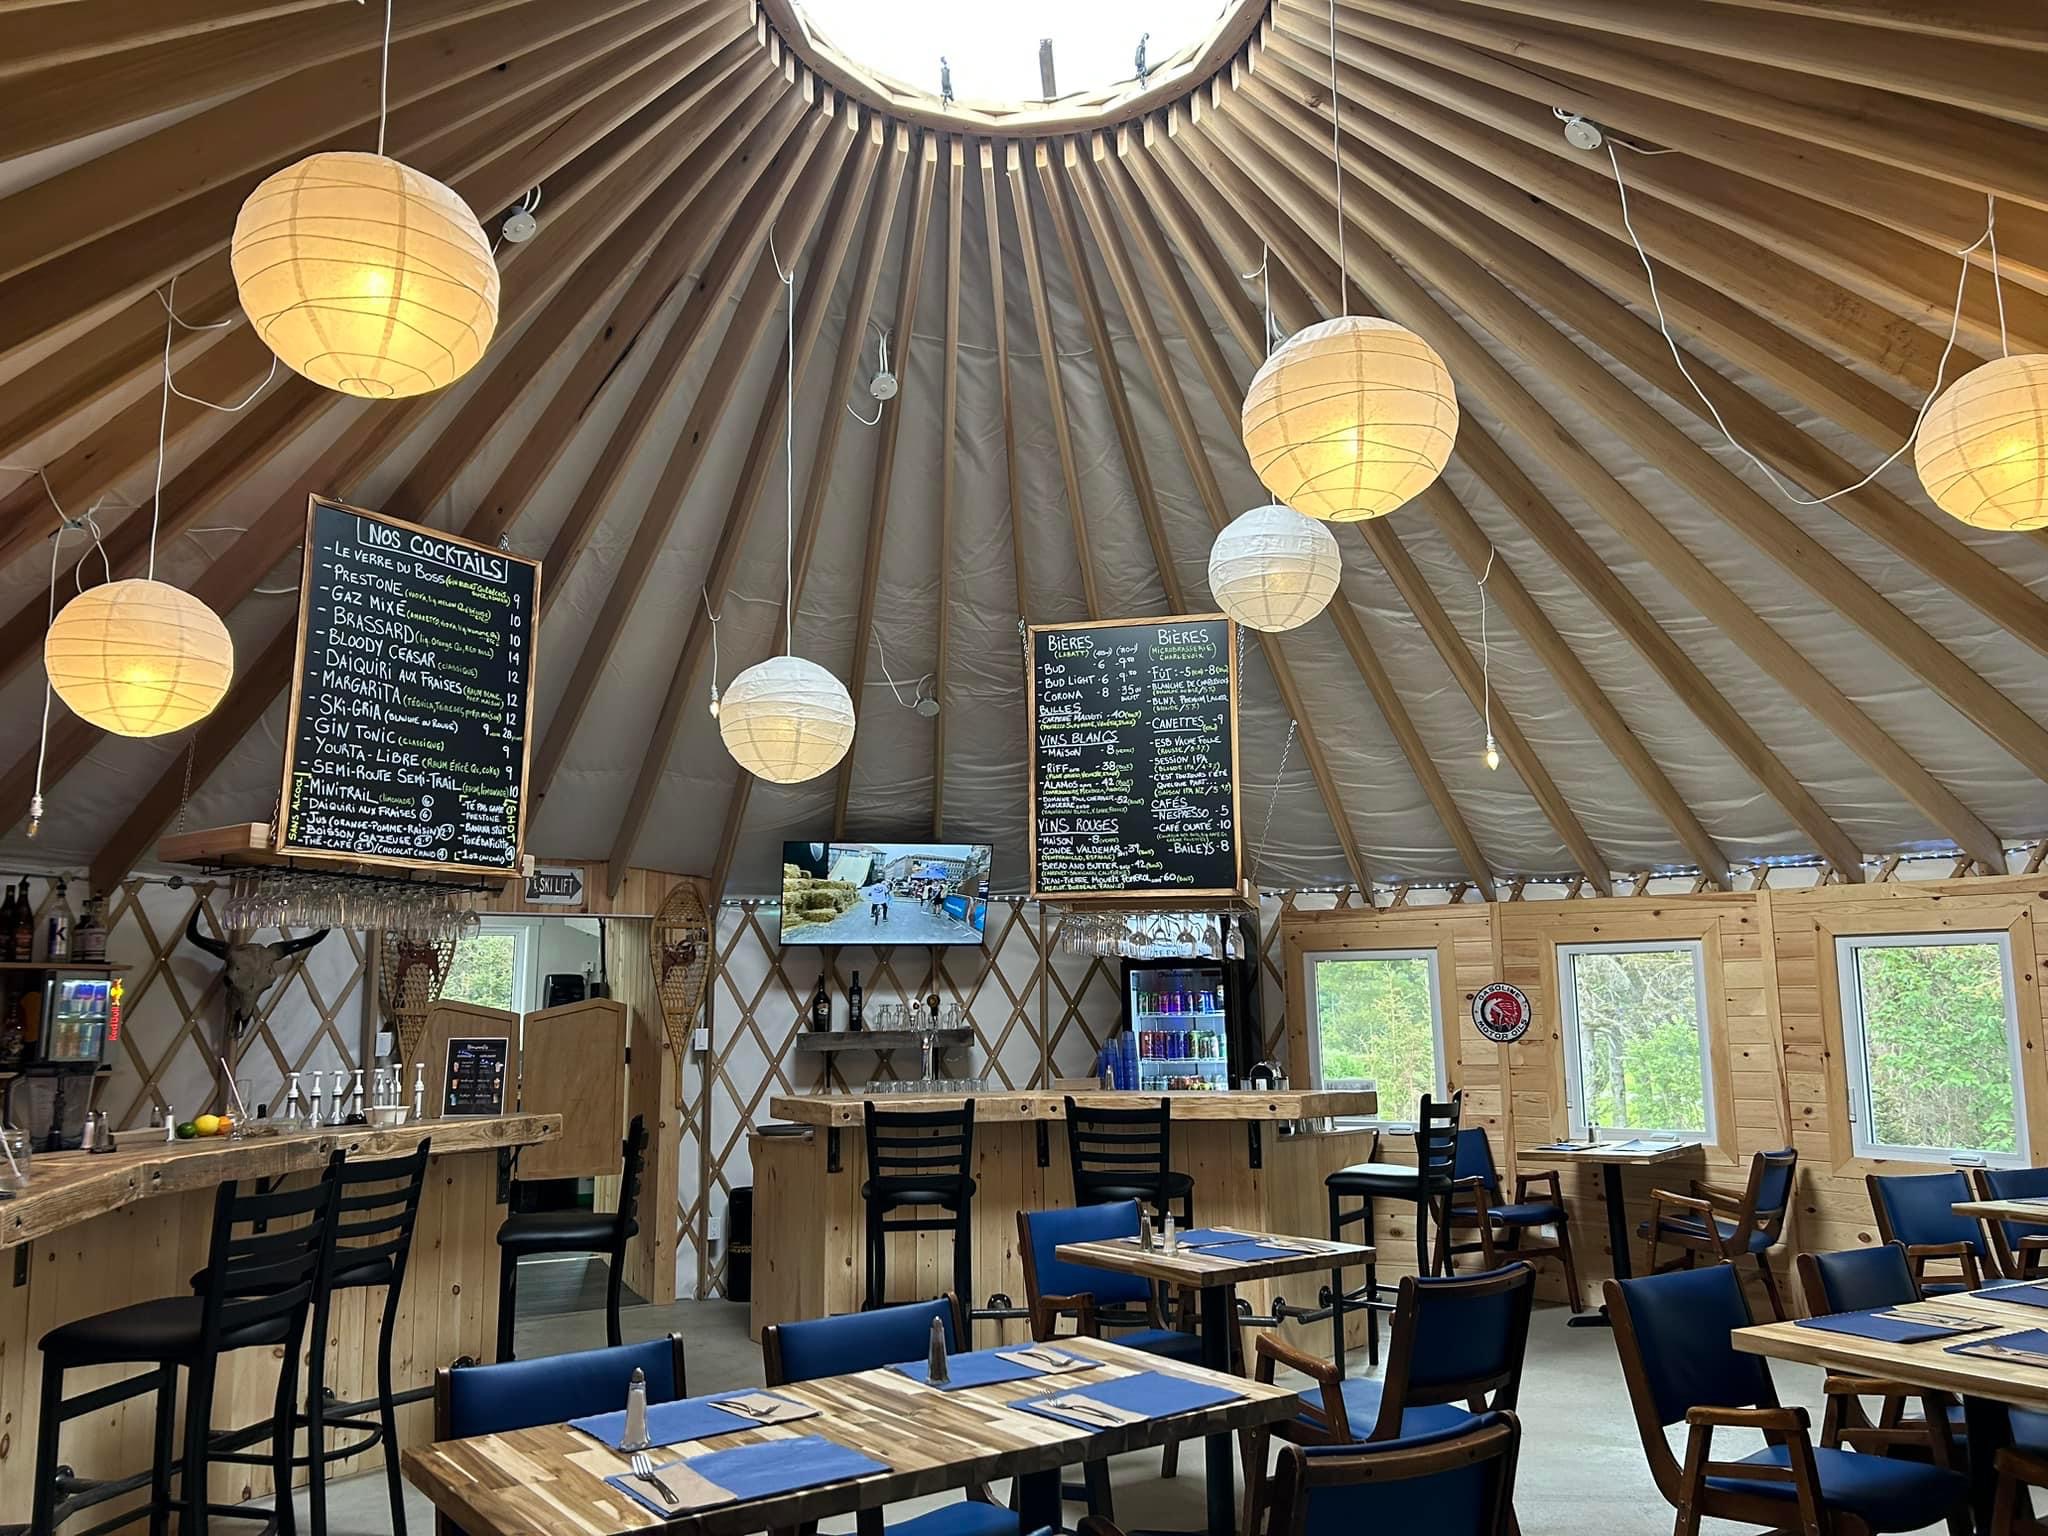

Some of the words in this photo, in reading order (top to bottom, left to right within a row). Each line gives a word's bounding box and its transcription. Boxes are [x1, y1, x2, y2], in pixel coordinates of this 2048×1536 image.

[369, 523, 401, 549] NOS
[335, 540, 351, 558] LE
[355, 549, 394, 570] VERRE
[397, 561, 411, 574] DU
[513, 593, 520, 610] 9
[334, 563, 403, 597] PRESTONE
[510, 613, 521, 628] 10
[332, 585, 362, 605] GAZ
[510, 633, 521, 648] 10
[334, 606, 415, 645] BRASSARD
[508, 650, 520, 666] 14
[329, 627, 383, 657] BLOODY
[388, 644, 436, 669] CEASAR
[508, 669, 520, 684] 12
[1044, 663, 1066, 675] BUD
[1097, 659, 1106, 669] 6
[1184, 666, 1192, 677] 5
[1208, 664, 1216, 675] 8
[399, 668, 417, 684] AUX
[507, 692, 519, 708] 12
[1044, 678, 1066, 689] BUD
[1101, 673, 1109, 685] 6
[1151, 681, 1184, 691] BLANCHE
[1043, 689, 1084, 702] CORONA
[1101, 686, 1110, 698] 8
[1121, 683, 1135, 696] 35
[1039, 702, 1082, 715] BULLES
[506, 712, 517, 726] 12
[1151, 715, 1205, 729] CANETTES
[1217, 714, 1224, 725] 9
[483, 723, 490, 736] 9
[502, 727, 512, 740] 28
[1071, 730, 1118, 744] BLANCS
[1106, 744, 1115, 755] 8
[1154, 738, 1172, 748] ESB
[502, 745, 510, 759] 9
[1192, 754, 1208, 764] IPA
[1101, 760, 1116, 771] 38
[505, 765, 513, 781] 9
[1043, 780, 1079, 790] ALAMOS
[1101, 778, 1115, 789] 42
[291, 777, 303, 811] ALCOOL
[509, 784, 519, 799] 10
[1151, 796, 1189, 809] CAFÉS
[306, 811, 327, 824] JUS
[358, 805, 376, 816] AUX
[465, 812, 501, 823] PRESTONE
[1158, 808, 1210, 820] NESPRESSO
[1219, 805, 1230, 816] 5
[288, 814, 300, 841] SANS
[1075, 818, 1119, 832] ROUGES
[1159, 820, 1181, 832] CAFÉ
[1220, 819, 1231, 830] 10
[358, 831, 412, 846] GAZEUSE
[1091, 834, 1101, 844] 8
[1042, 845, 1075, 855] CONDE
[1076, 844, 1120, 855] VALDEMAR
[1220, 840, 1230, 852] 8
[1041, 861, 1067, 871] BREAD
[1068, 862, 1085, 870] AND
[1086, 861, 1119, 871] BUTTER
[1163, 871, 1177, 881] 60
[539, 877, 553, 893] SKI
[555, 878, 574, 894] LIFT
[1478, 985, 1521, 1001] GASOLINE
[1478, 1021, 1509, 1040] MOTOR
[1511, 1019, 1528, 1037] OILS
